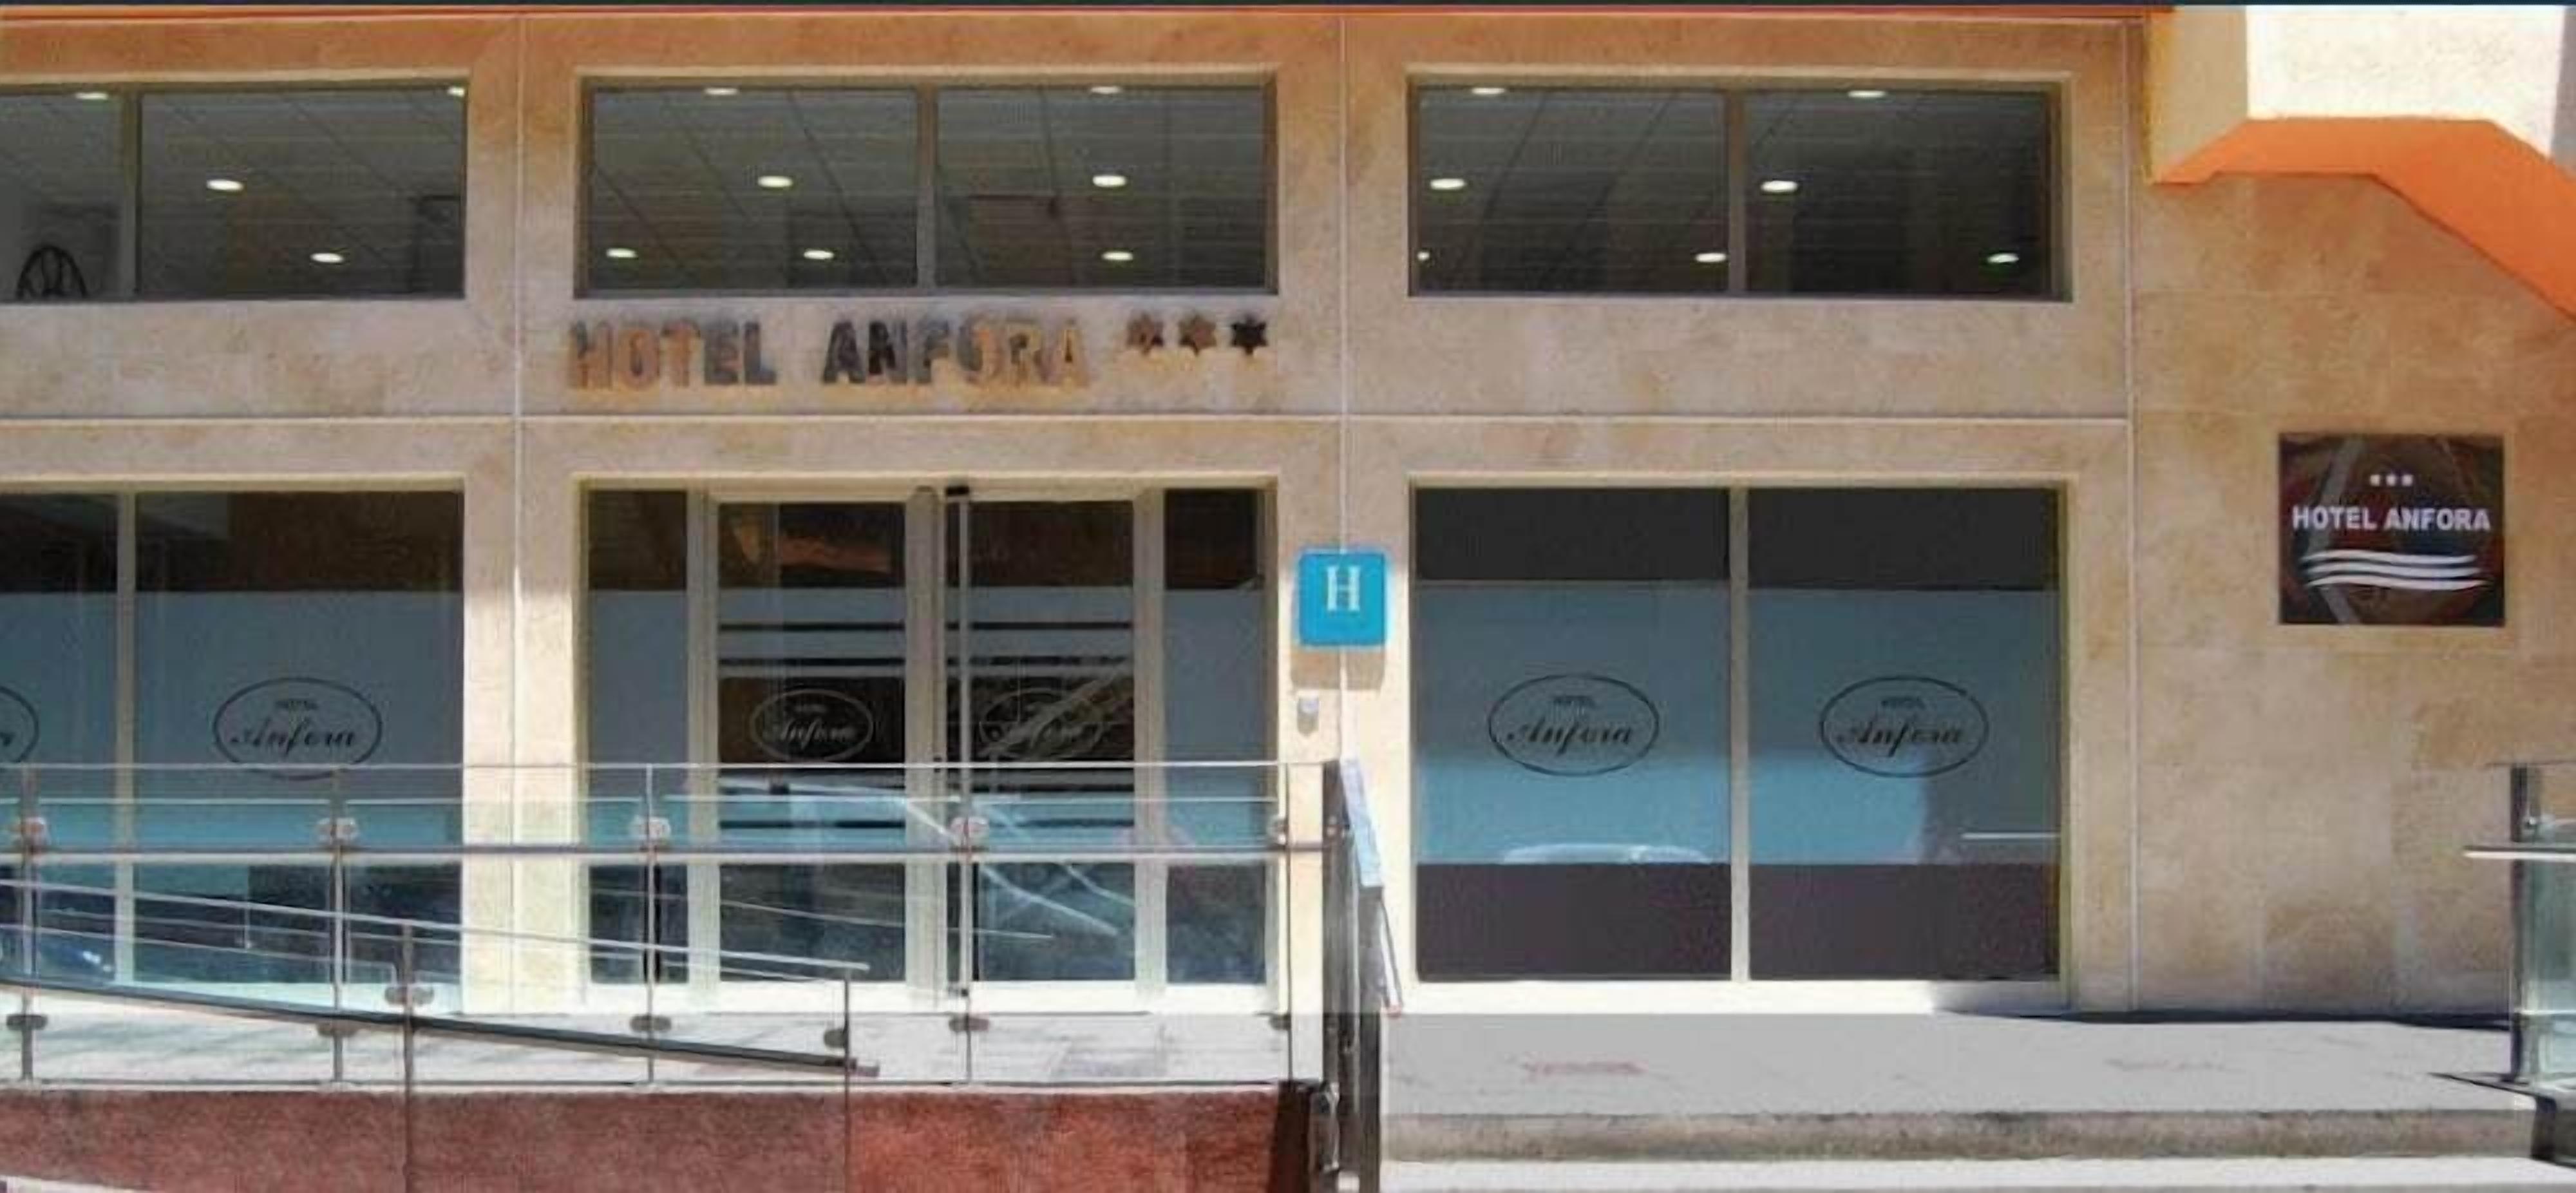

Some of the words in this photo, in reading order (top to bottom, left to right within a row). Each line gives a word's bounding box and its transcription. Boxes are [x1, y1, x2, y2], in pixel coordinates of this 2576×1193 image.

[567, 320, 777, 389] HOTEL
[822, 318, 1090, 389] ANFORA
[2292, 506, 2378, 531] HOTEL
[2384, 507, 2491, 532] ANFORA
[1326, 565, 1361, 613] H
